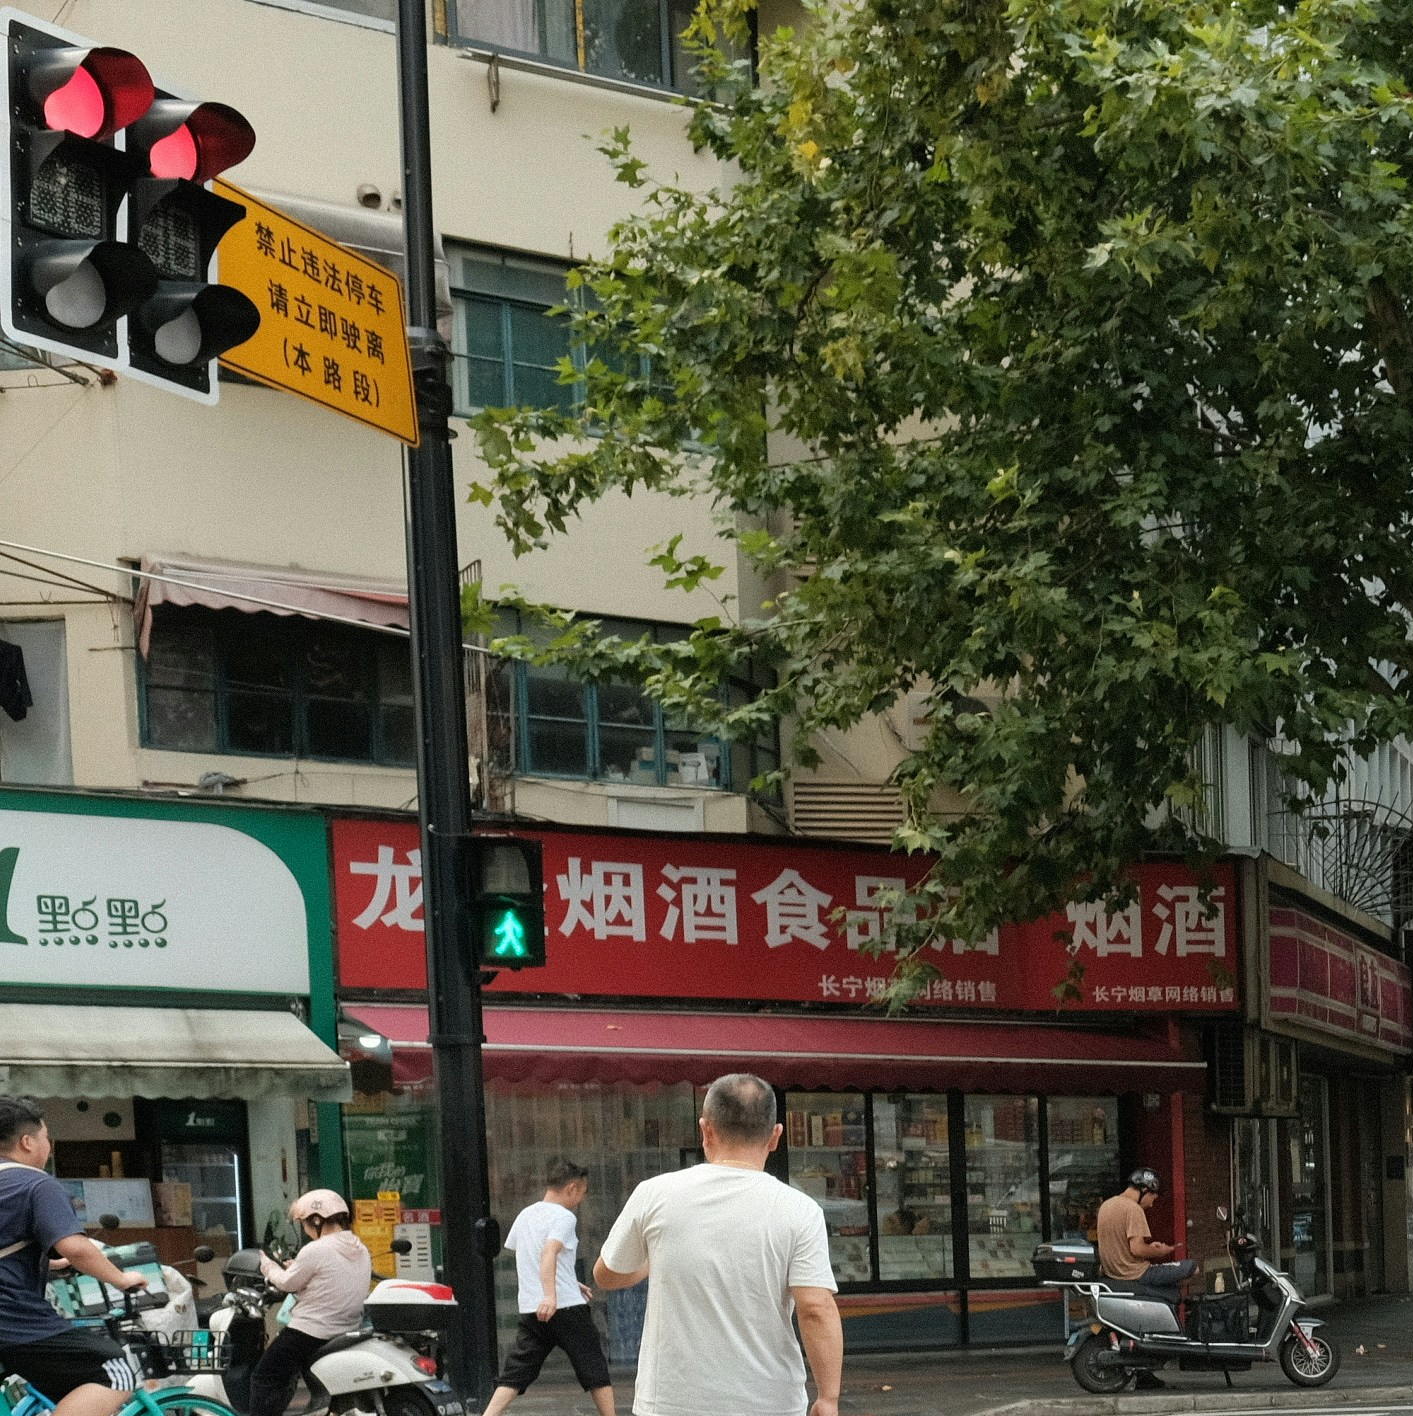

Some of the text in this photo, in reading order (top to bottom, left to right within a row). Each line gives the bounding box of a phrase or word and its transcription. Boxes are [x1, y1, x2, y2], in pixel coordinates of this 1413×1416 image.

[255, 221, 385, 316] 禁止违法停车
[268, 279, 385, 365] 请立即驶离
[1066, 884, 1226, 958] 烟酒
[1092, 985, 1234, 1004] 长宁烟草网络销售
